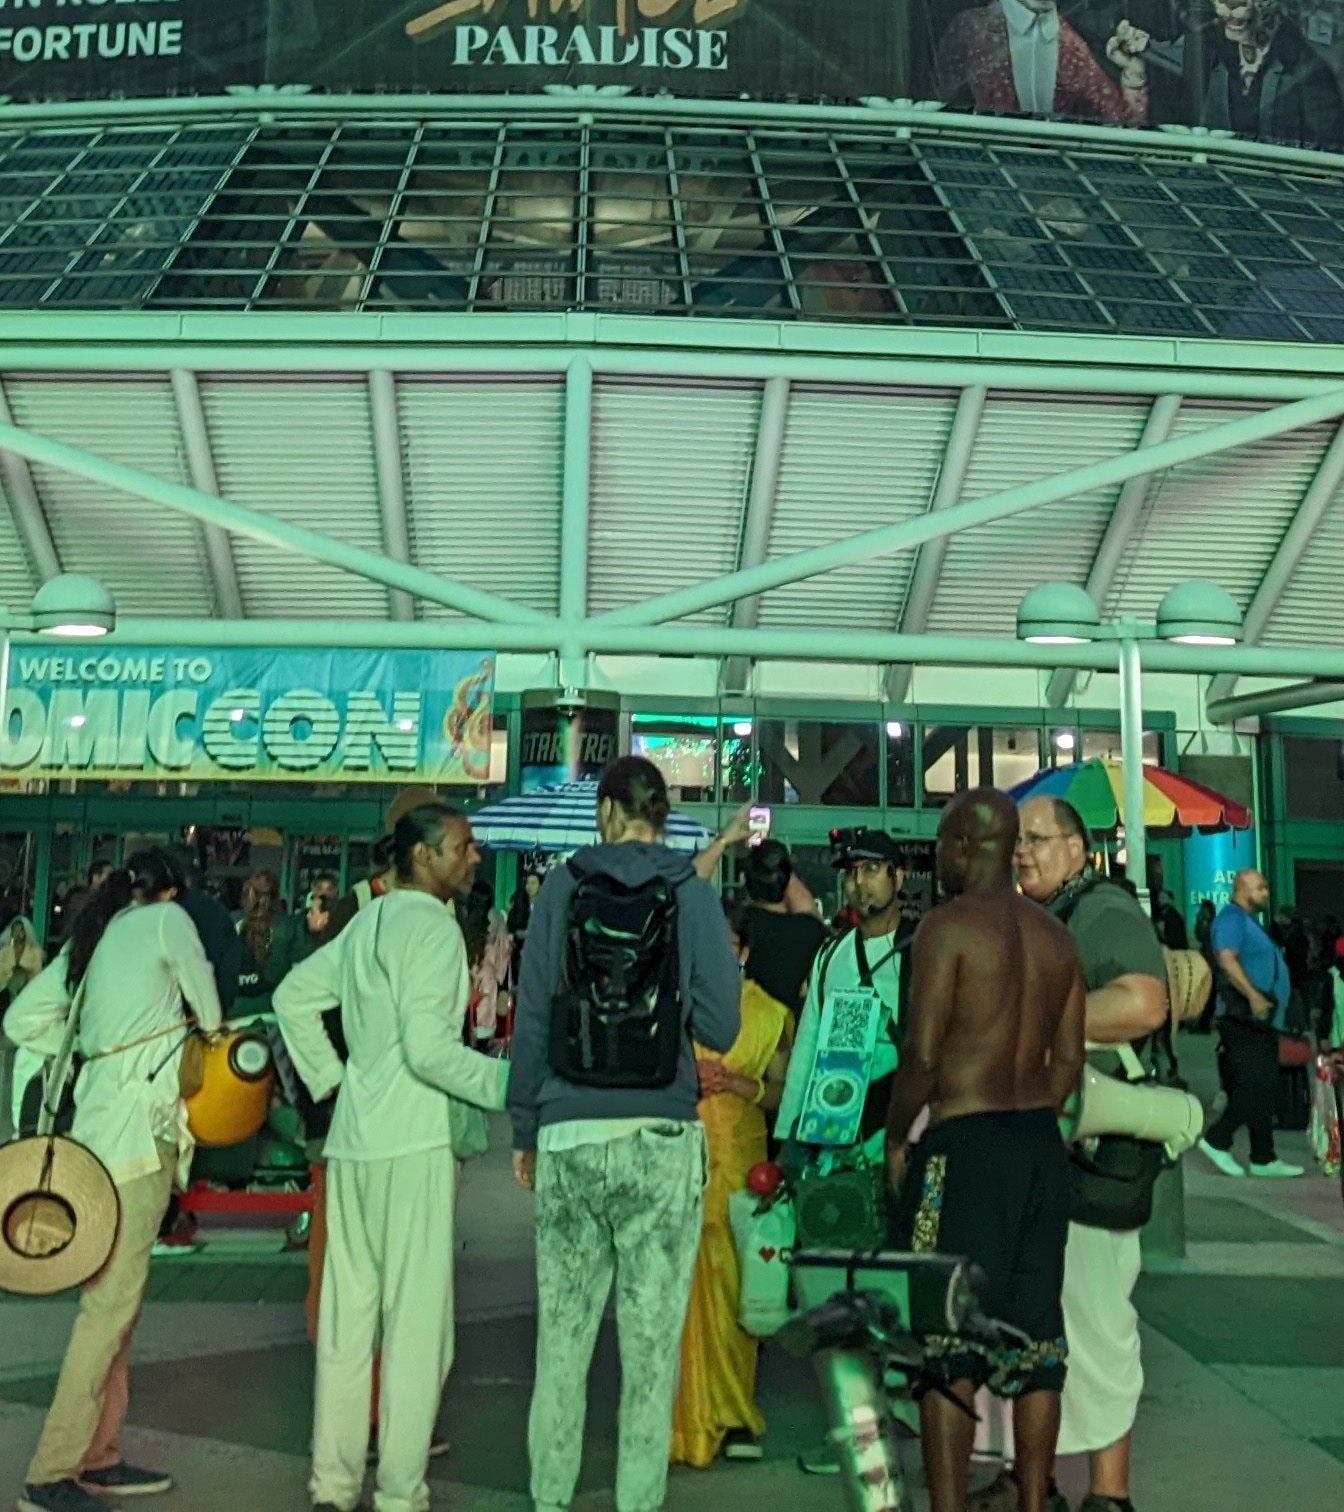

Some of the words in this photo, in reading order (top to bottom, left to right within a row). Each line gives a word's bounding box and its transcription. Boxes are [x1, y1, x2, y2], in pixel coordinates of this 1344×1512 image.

[452, 24, 728, 69] PARADISE
[19, 657, 164, 683] WELCOME
[174, 658, 213, 683] TO
[202, 689, 421, 771] CON
